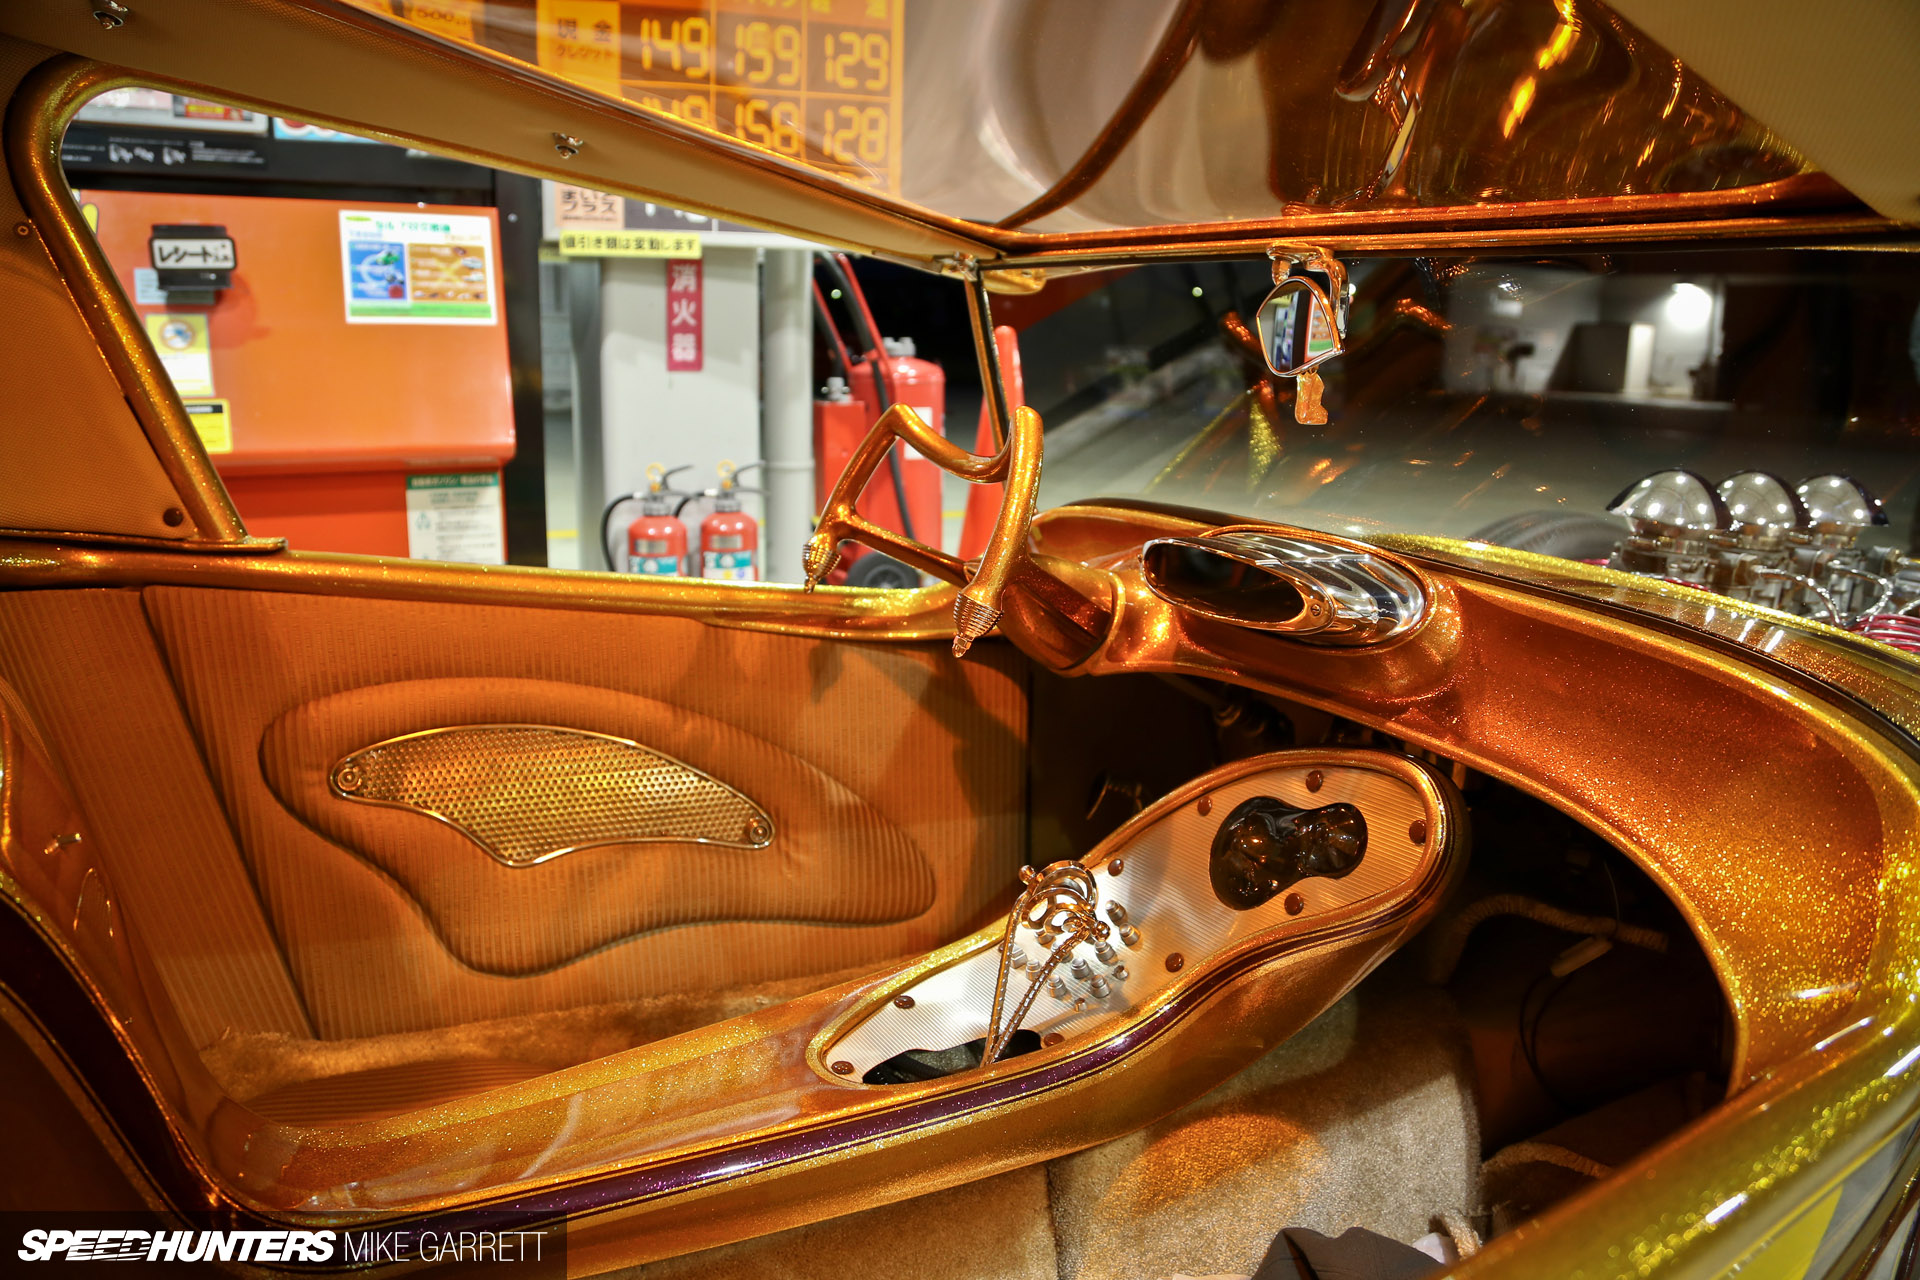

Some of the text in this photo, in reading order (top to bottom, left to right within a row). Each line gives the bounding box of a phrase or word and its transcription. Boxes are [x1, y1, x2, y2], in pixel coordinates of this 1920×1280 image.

[641, 17, 889, 91] 149 159 129
[823, 106, 888, 163] 128
[564, 235, 696, 251] 値引き額は変動します
[672, 264, 697, 362] 消火器
